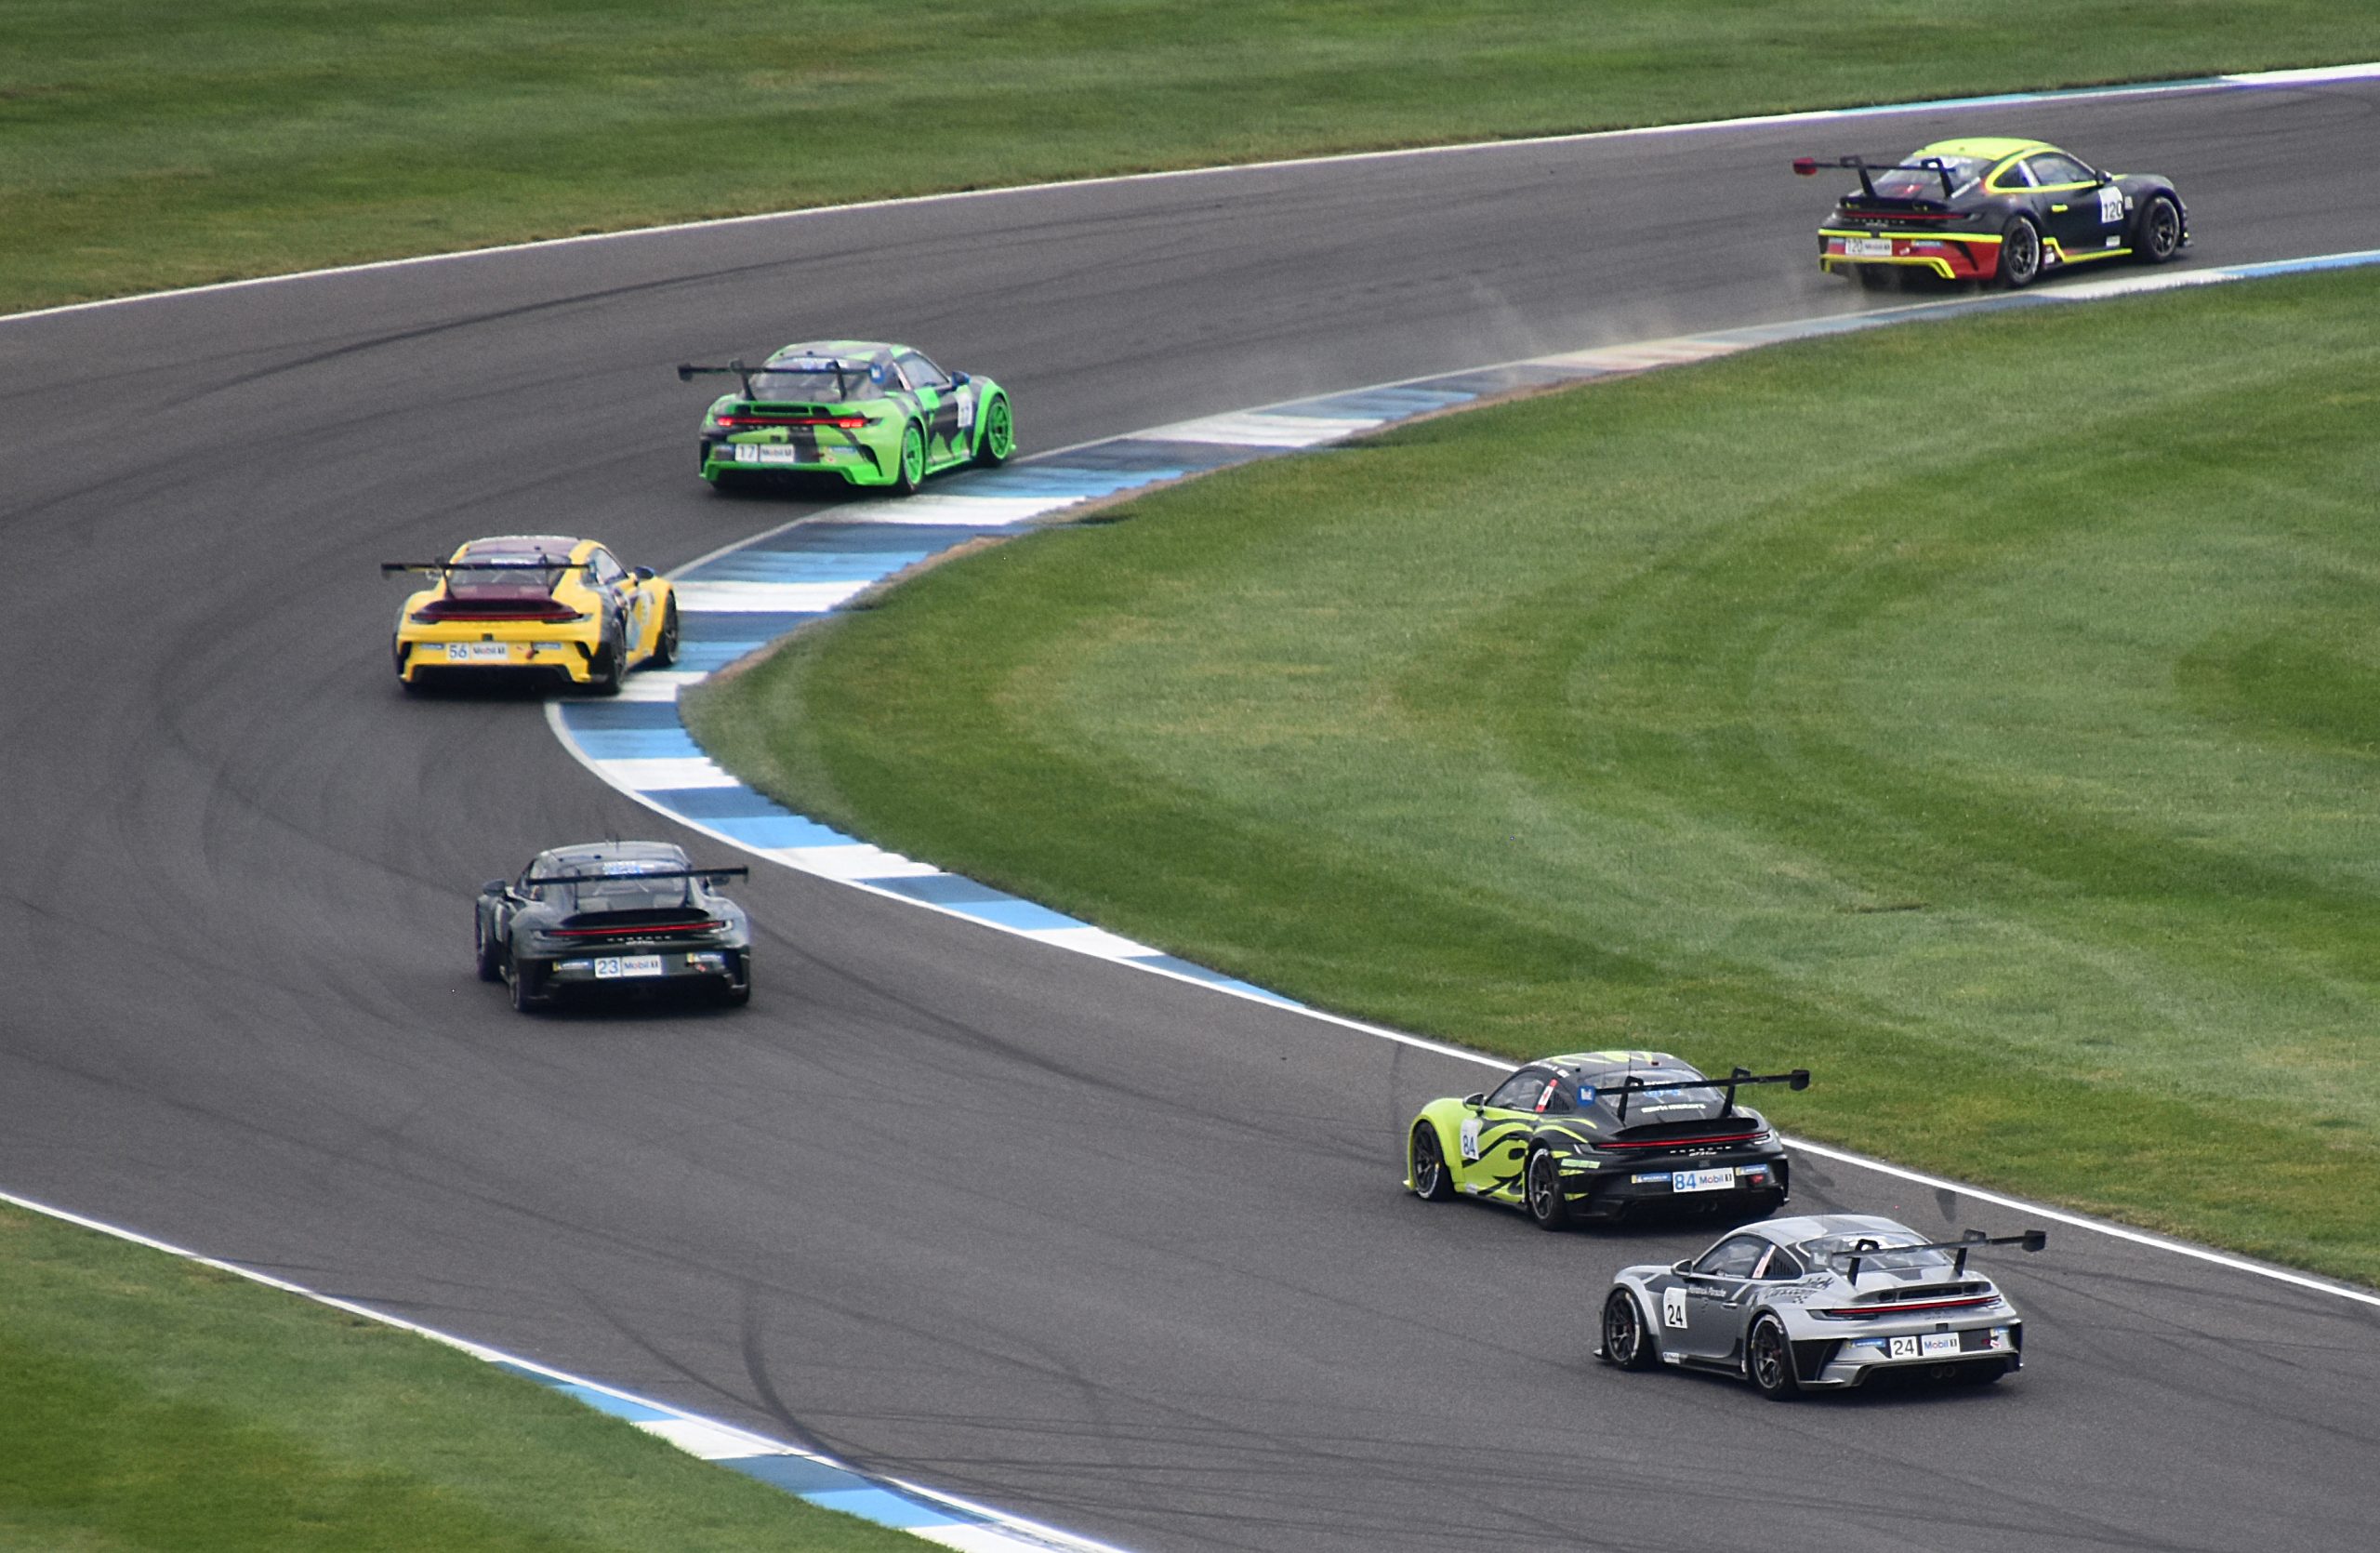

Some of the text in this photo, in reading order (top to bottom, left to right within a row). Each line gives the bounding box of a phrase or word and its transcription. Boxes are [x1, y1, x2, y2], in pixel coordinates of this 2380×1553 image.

[2104, 201, 2123, 219] 120
[1847, 238, 1863, 254] 120
[740, 445, 755, 458] 17
[449, 644, 468, 658] 56
[597, 960, 619, 975] 23
[624, 960, 649, 970] Mobil
[1462, 1134, 1476, 1157] 84
[1674, 1174, 1697, 1190] 84
[1699, 1173, 1724, 1184] Mobil
[1667, 1304, 1683, 1326] 24
[1893, 1339, 1915, 1356] 24
[1924, 1339, 1949, 1350] Mobil
